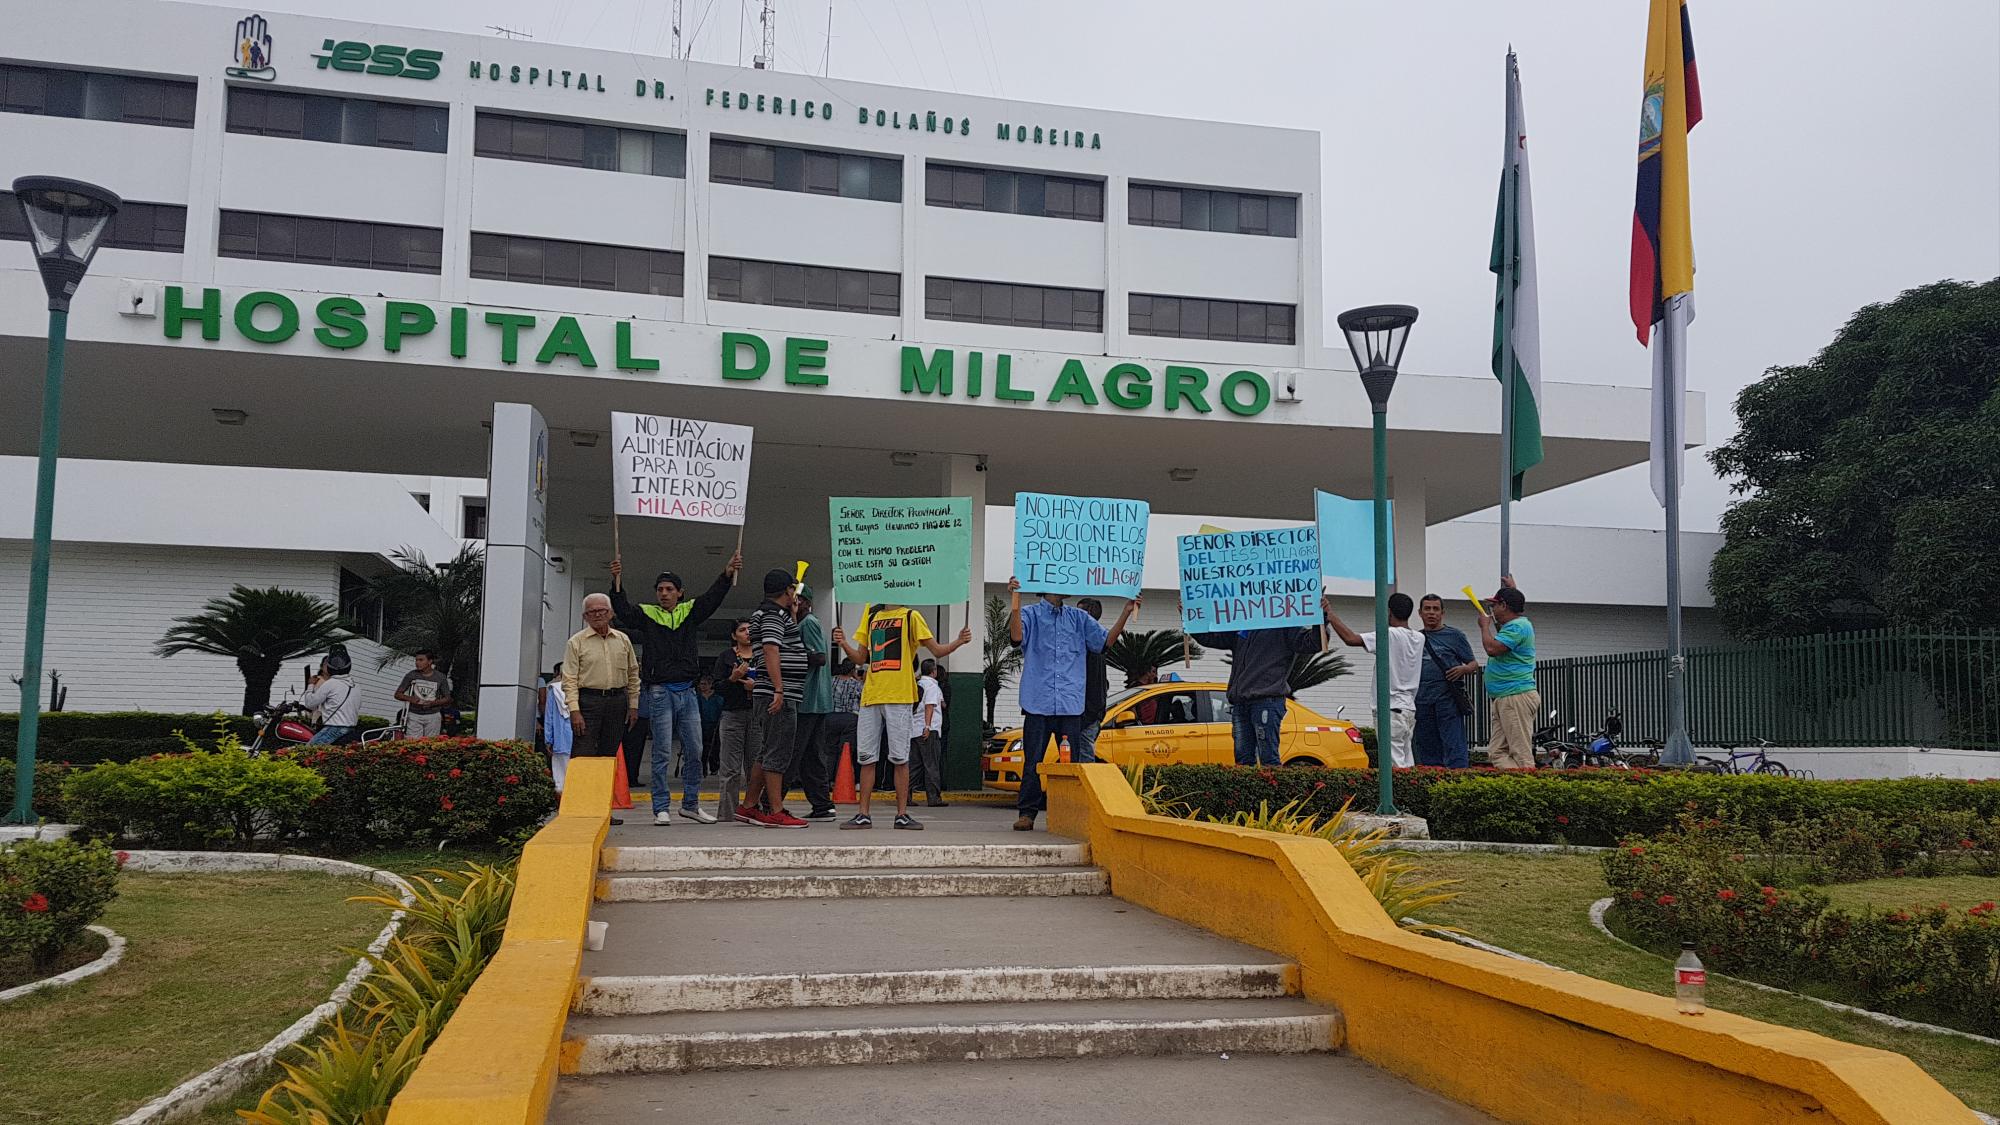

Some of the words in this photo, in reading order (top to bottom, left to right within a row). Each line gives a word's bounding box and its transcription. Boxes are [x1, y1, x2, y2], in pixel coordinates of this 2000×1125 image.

[469, 60, 606, 93] HOSPITAL
[636, 79, 674, 101] DR.
[706, 88, 833, 120] FEDERICO
[858, 106, 971, 136] BOLAÑOS
[997, 122, 1101, 150] MOREIRA
[163, 285, 661, 372] HOSPITAL
[721, 331, 829, 386] DE
[900, 345, 1271, 416] MILAGRO
[635, 416, 659, 436] NO
[670, 419, 708, 440] HAY
[632, 456, 678, 475] PARA
[686, 461, 716, 478] LOS
[631, 476, 737, 500] INTERNOS
[1025, 496, 1050, 518] NO
[1052, 499, 1085, 521] HAY
[1023, 518, 1116, 543] SOLUCIONE
[1121, 526, 1145, 545] LOS
[868, 546, 893, 556] MISMO
[896, 544, 936, 555] PROBLEMA
[1026, 541, 1130, 564] PROBLEMAS
[1188, 552, 1216, 566] DEL
[1218, 548, 1259, 563] IESS
[1265, 544, 1318, 561] MILAGRO
[888, 558, 898, 567] SU
[1026, 563, 1080, 585] IESS
[1184, 563, 1255, 581] NUESTROS
[1256, 558, 1320, 576] INTERNOS
[1186, 582, 1234, 601] ESTAN
[1240, 577, 1318, 597] MURIENDO
[1187, 607, 1206, 622] DE
[1213, 594, 1315, 625] HAMBRE
